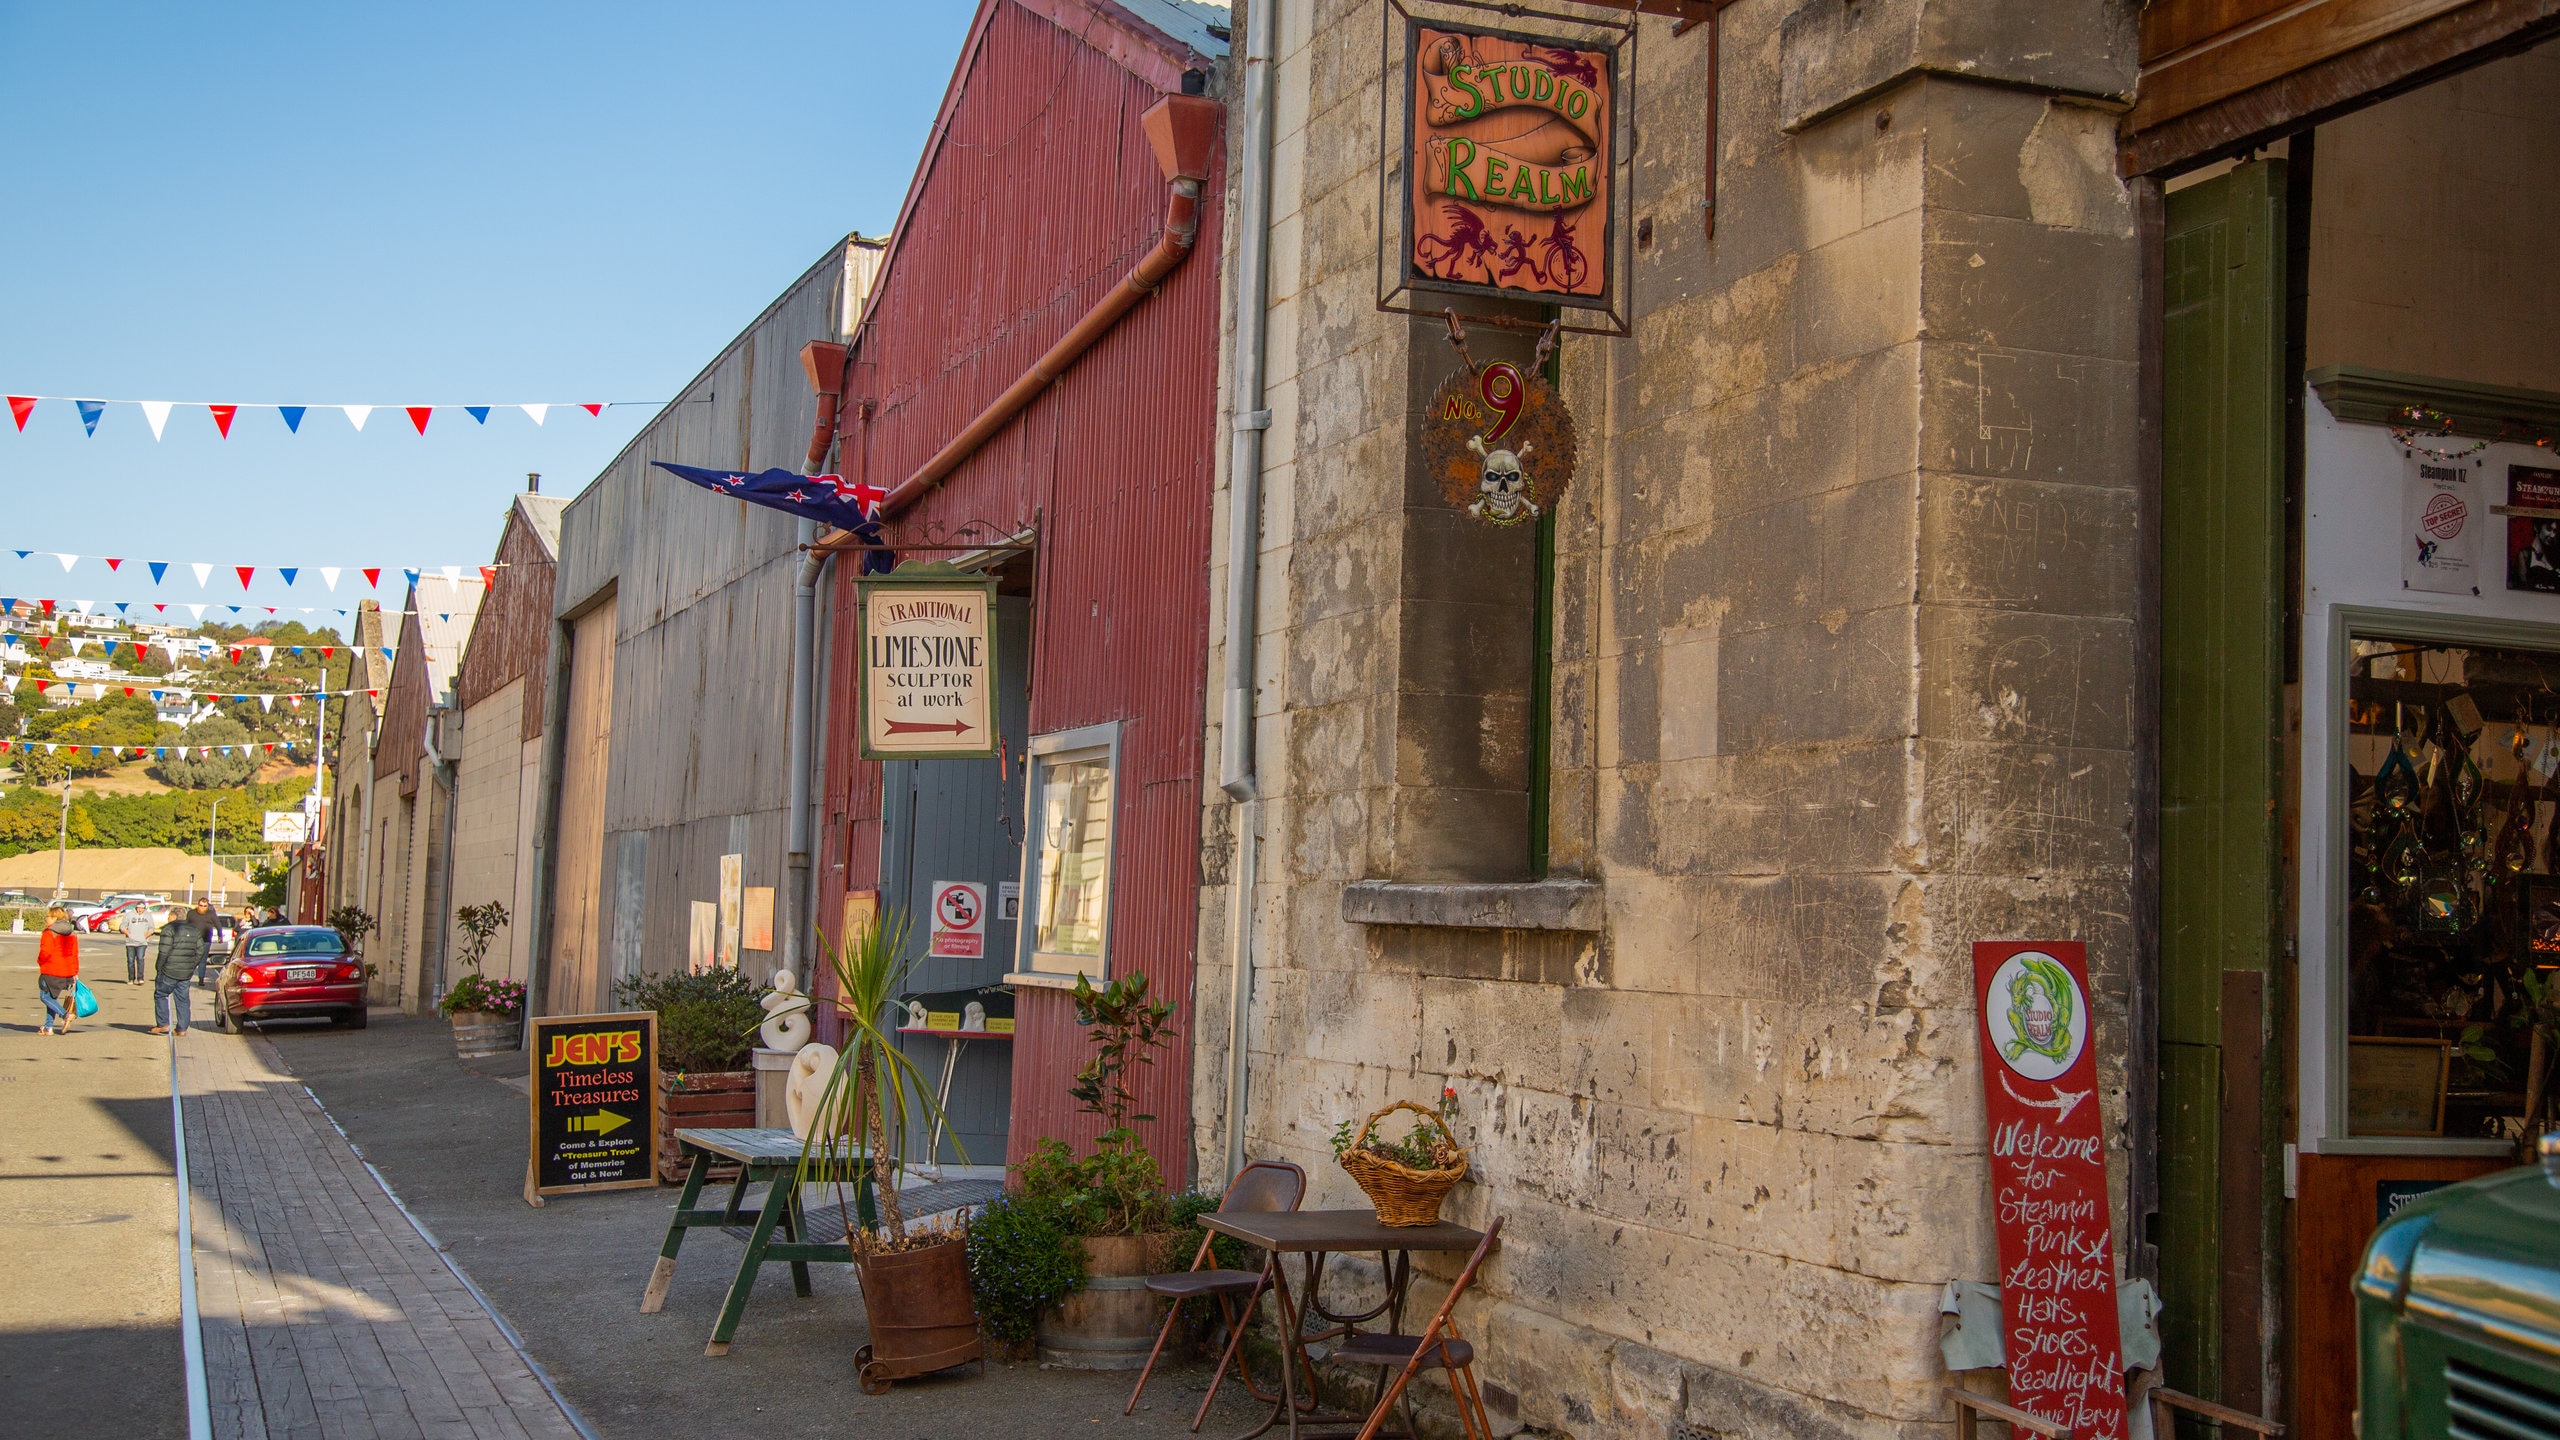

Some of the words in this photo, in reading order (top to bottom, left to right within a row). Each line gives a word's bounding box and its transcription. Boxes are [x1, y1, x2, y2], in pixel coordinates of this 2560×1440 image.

[1450, 64, 1588, 119] STUDIO
[1446, 137, 1592, 205] REALM
[1443, 394, 1482, 421] No.
[1479, 361, 1526, 445] 9
[2420, 463, 2457, 482] Steampunk
[2458, 468, 2467, 483] NZ
[2425, 516, 2438, 527] TOP
[2439, 506, 2464, 521] SECRET
[887, 601, 972, 624] TRADITIONAL
[871, 635, 983, 668] LIMESTONE
[886, 673, 973, 688] SCULPTOR
[897, 692, 913, 707] at
[923, 691, 964, 707] work
[944, 937, 979, 945] photography
[951, 943, 970, 951] filming
[2026, 1008, 2053, 1022] STUDIO
[2026, 1022, 2052, 1038] REALM
[546, 1030, 641, 1067] JEN'S
[556, 1069, 634, 1088] Timeless
[551, 1088, 639, 1107] Treasures
[560, 1142, 586, 1150] Come
[588, 1140, 596, 1148] &
[598, 1138, 634, 1148] Explore
[1993, 1119, 2101, 1165] Welcome
[553, 1153, 561, 1161] A
[568, 1162, 578, 1170] of
[580, 1160, 625, 1169] Memories
[571, 1172, 587, 1180] Old
[589, 1171, 596, 1179] &
[599, 1169, 623, 1178] New!
[2011, 1160, 2066, 1190] For
[2023, 1223, 2089, 1256] Punk
